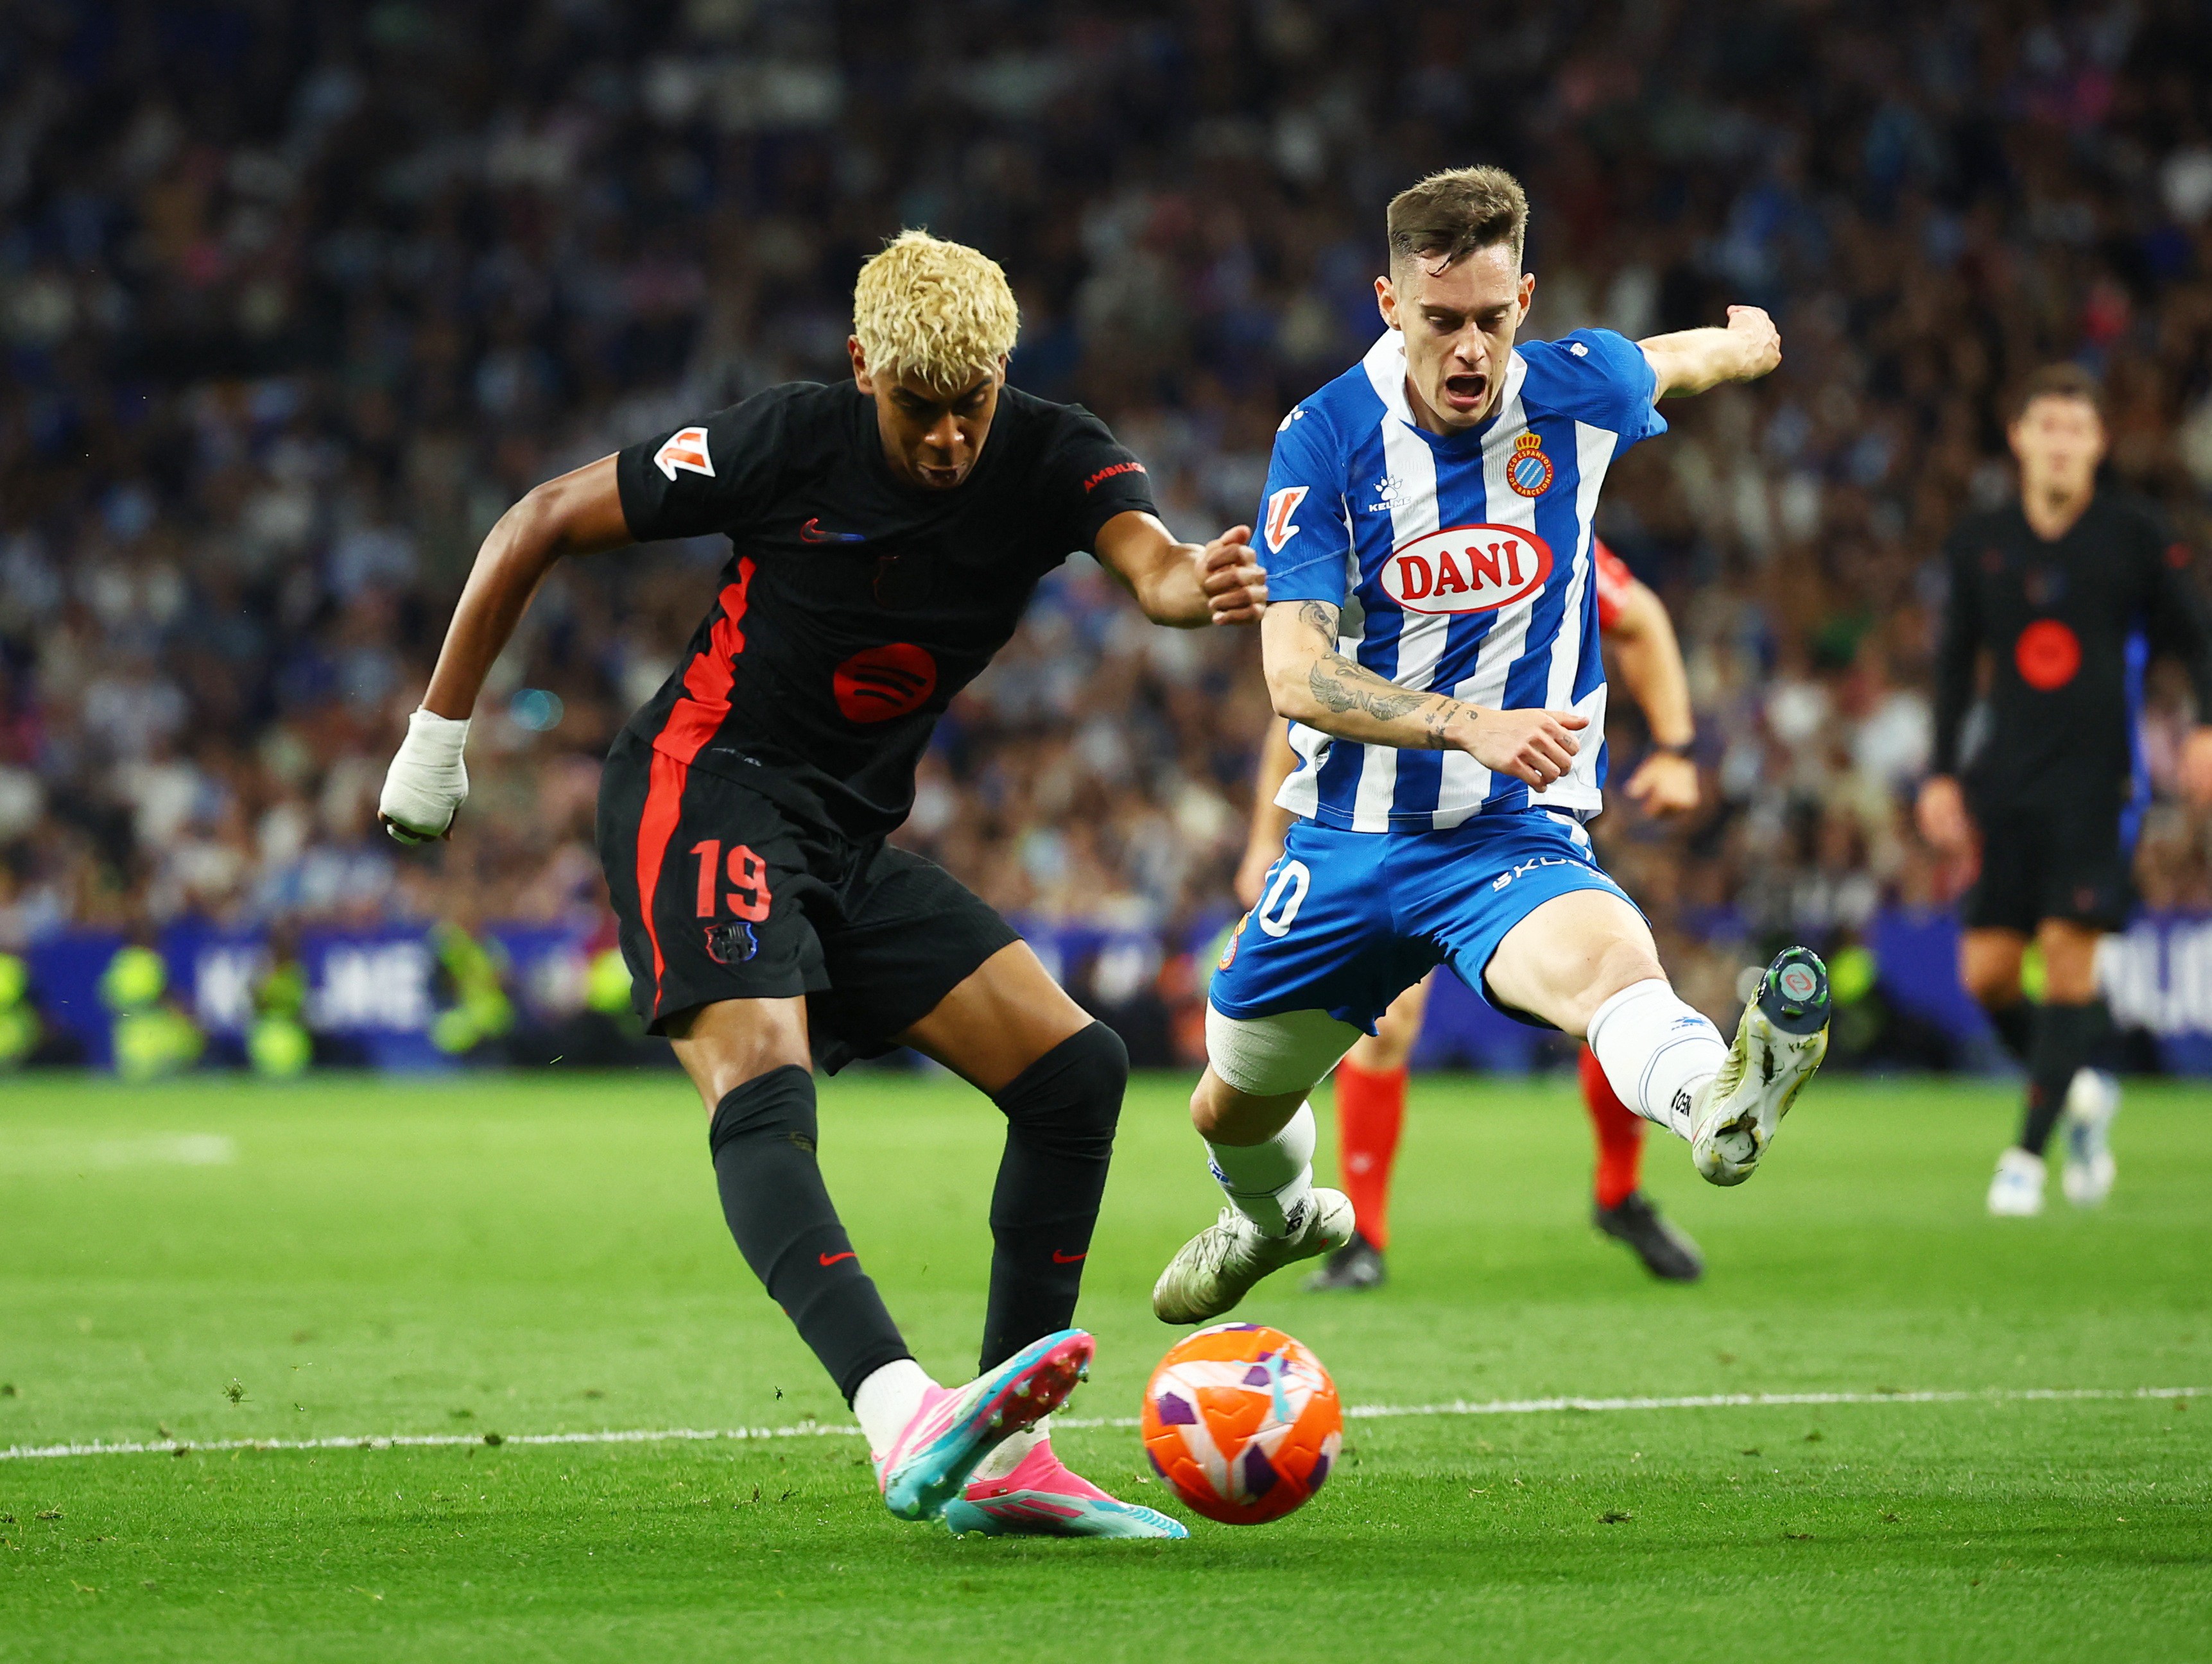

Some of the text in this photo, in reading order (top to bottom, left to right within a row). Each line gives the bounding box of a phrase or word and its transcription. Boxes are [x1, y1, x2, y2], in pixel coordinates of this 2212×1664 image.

[1517, 450, 1551, 469] ESPANYOL
[1369, 496, 1412, 512] KELME
[1517, 474, 1553, 496] BARCELONA
[1396, 540, 1525, 601] DANI
[689, 839, 773, 923] 19
[1250, 851, 1310, 938] 0
